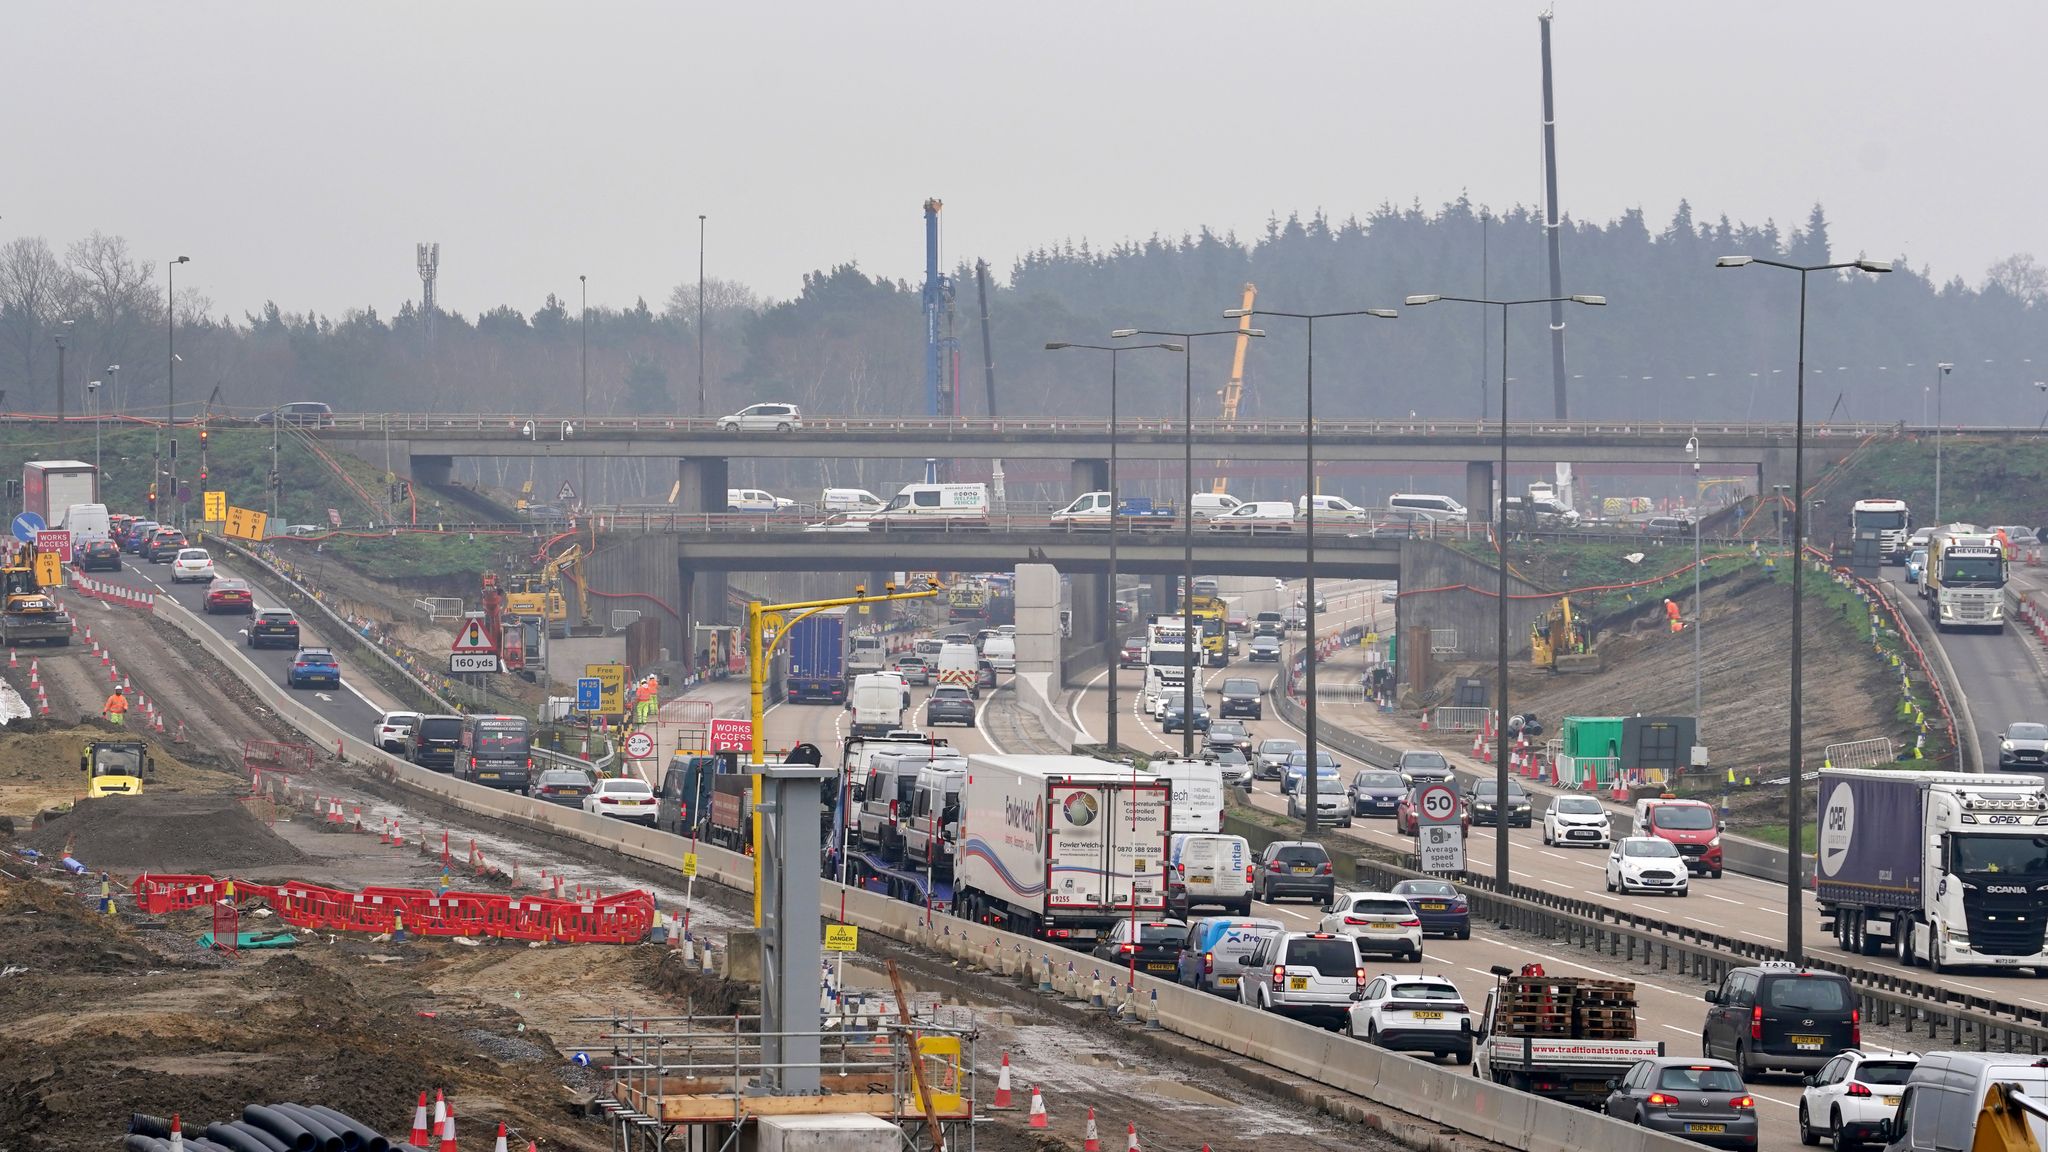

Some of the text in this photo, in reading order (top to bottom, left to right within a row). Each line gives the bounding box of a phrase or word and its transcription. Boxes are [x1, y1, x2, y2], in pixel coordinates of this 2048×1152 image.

[455, 658, 494, 670] 160 yds
[716, 724, 750, 732] WORKS
[1426, 796, 1451, 810] 50
[1006, 794, 1034, 833] Fowler Welch
[1829, 806, 1847, 830] OPEX
[1232, 842, 1241, 871] Initial
[1987, 886, 2027, 894] SCANIA
[1532, 1046, 1657, 1055] www.traditionalstone.co.uk
